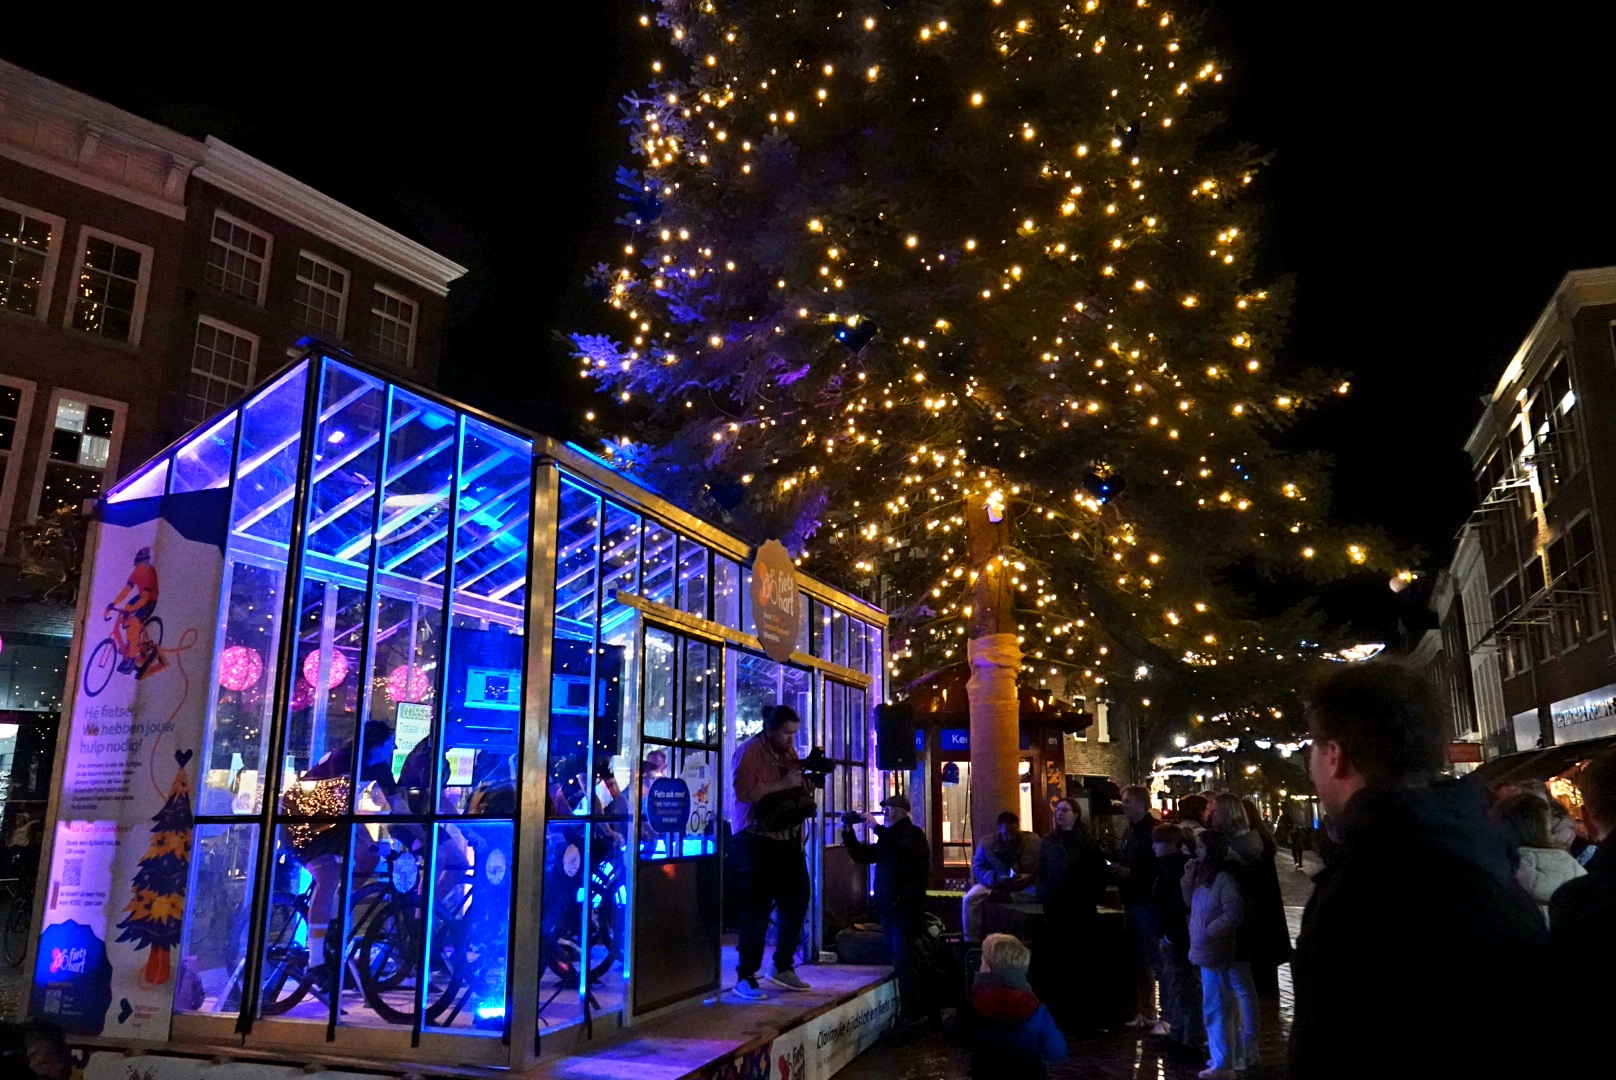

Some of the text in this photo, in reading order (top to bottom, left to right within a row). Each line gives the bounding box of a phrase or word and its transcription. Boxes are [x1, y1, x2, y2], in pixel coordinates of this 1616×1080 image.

[778, 570, 794, 593] fiets
[778, 591, 794, 617] hart
[84, 705, 100, 719] Hé
[83, 721, 176, 737] We hebben jouw
[399, 722, 420, 734] Totaal
[398, 738, 418, 750] Totaa
[952, 734, 968, 744] Ke
[1048, 738, 1058, 746] en
[80, 738, 143, 756] hulp nodig!
[70, 947, 87, 961] fiets
[68, 957, 86, 974] hart
[817, 1028, 838, 1049] Claim
[847, 1011, 869, 1036] tijdslot
